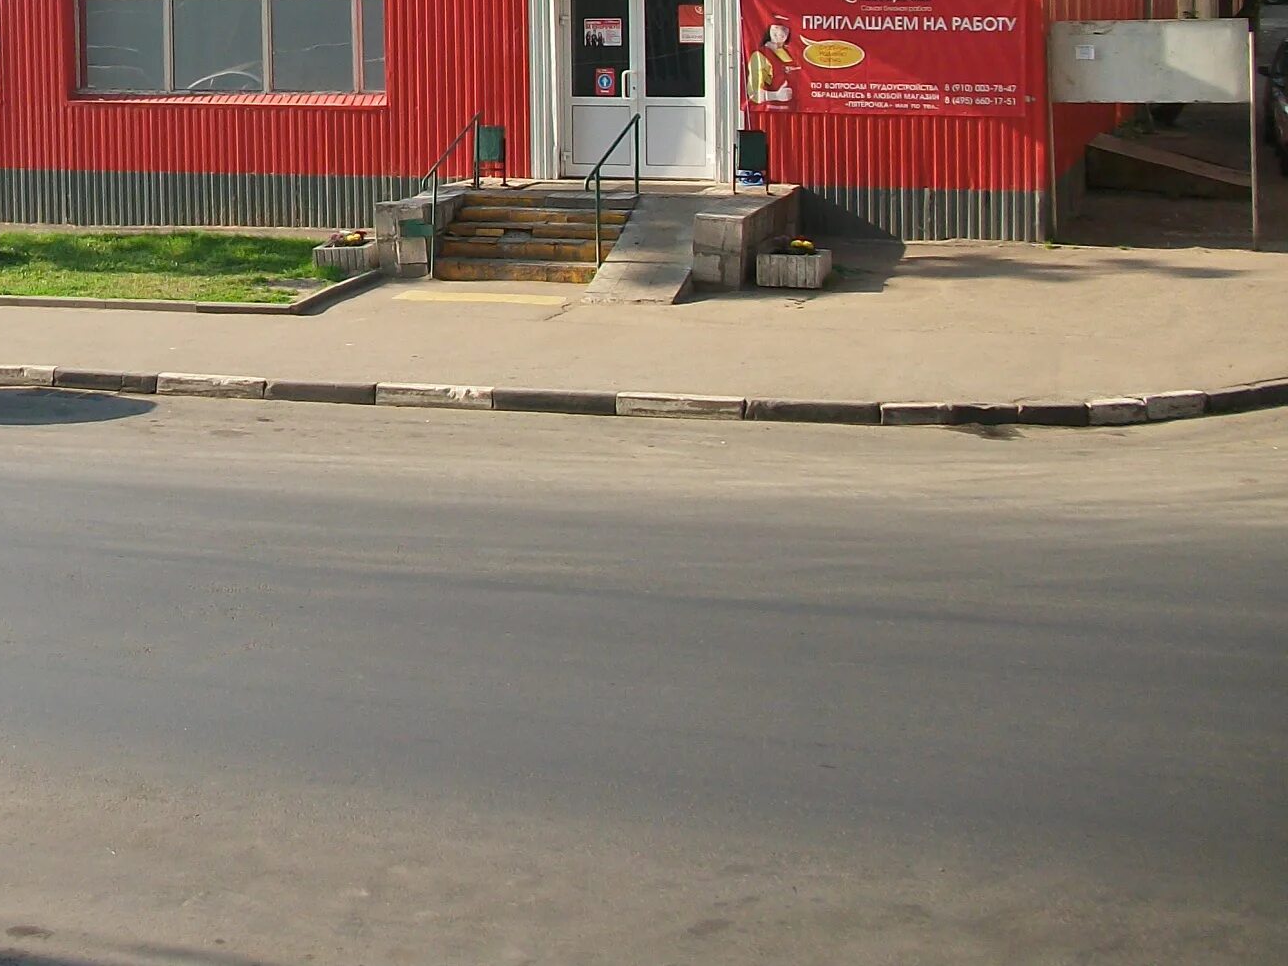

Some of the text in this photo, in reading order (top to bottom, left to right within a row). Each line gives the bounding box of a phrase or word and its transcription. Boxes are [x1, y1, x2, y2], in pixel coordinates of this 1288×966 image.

[802, 15, 1017, 32] ПРИГЛАШАЕМ НА РАБОТУ
[810, 82, 939, 91] ПО ВОПРОСАМ ТРУДОУСТРОЙСТВА
[944, 83, 950, 91] 8
[811, 91, 865, 99] ОБРАЩАЙТЕСЬ
[873, 92, 902, 100] ЛЮБОЙ
[944, 96, 950, 104] 8
[952, 97, 973, 105] (495)
